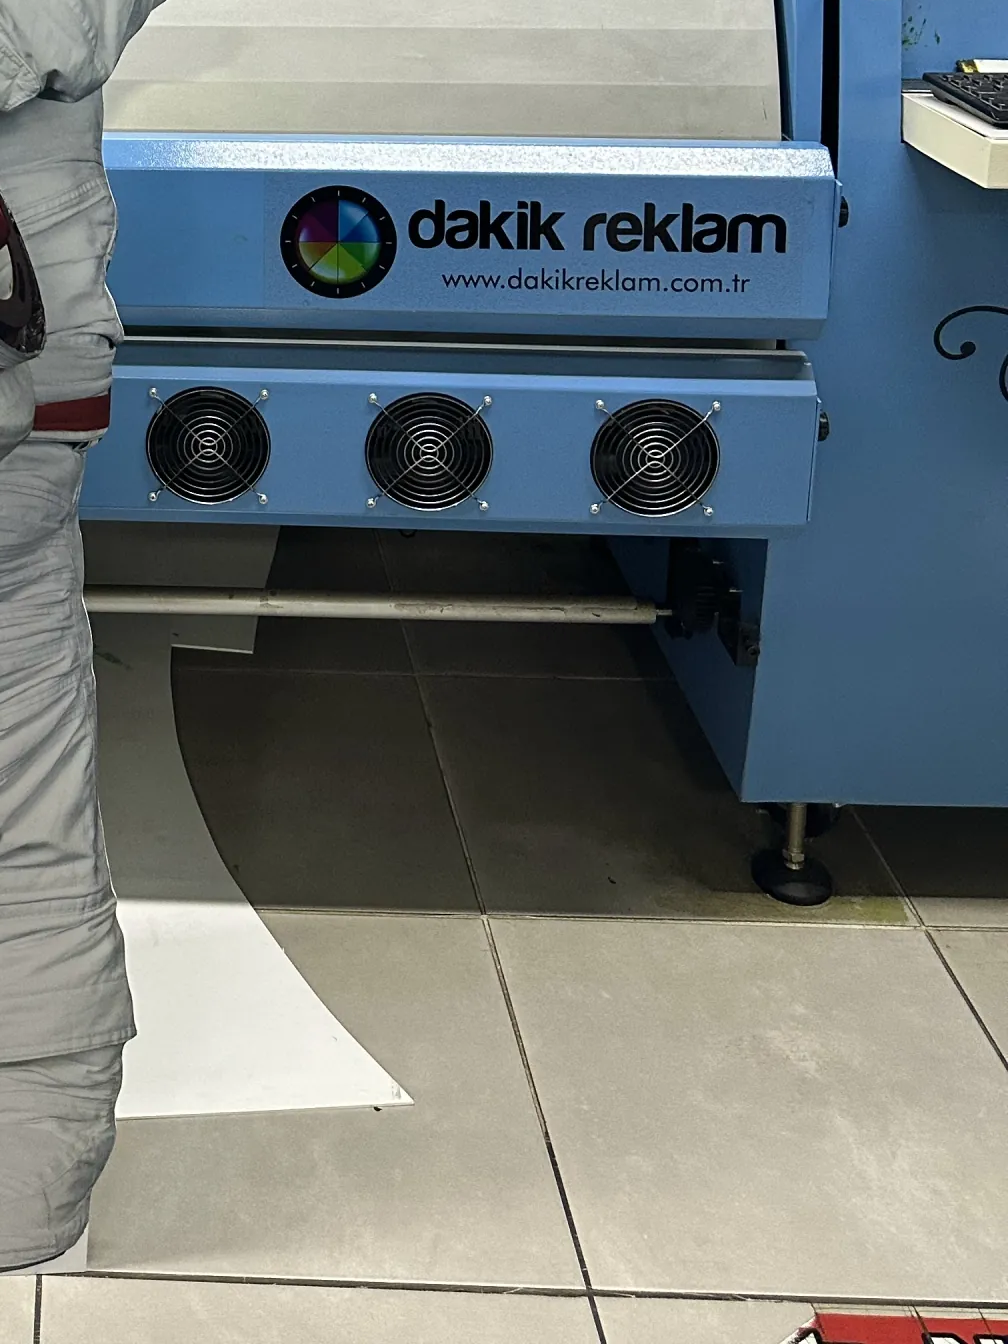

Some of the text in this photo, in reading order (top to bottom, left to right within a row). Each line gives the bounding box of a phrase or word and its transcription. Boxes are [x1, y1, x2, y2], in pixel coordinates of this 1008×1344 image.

[407, 199, 787, 254] dakik reklam
[441, 266, 751, 294] www.dakikreklam.com.tr
